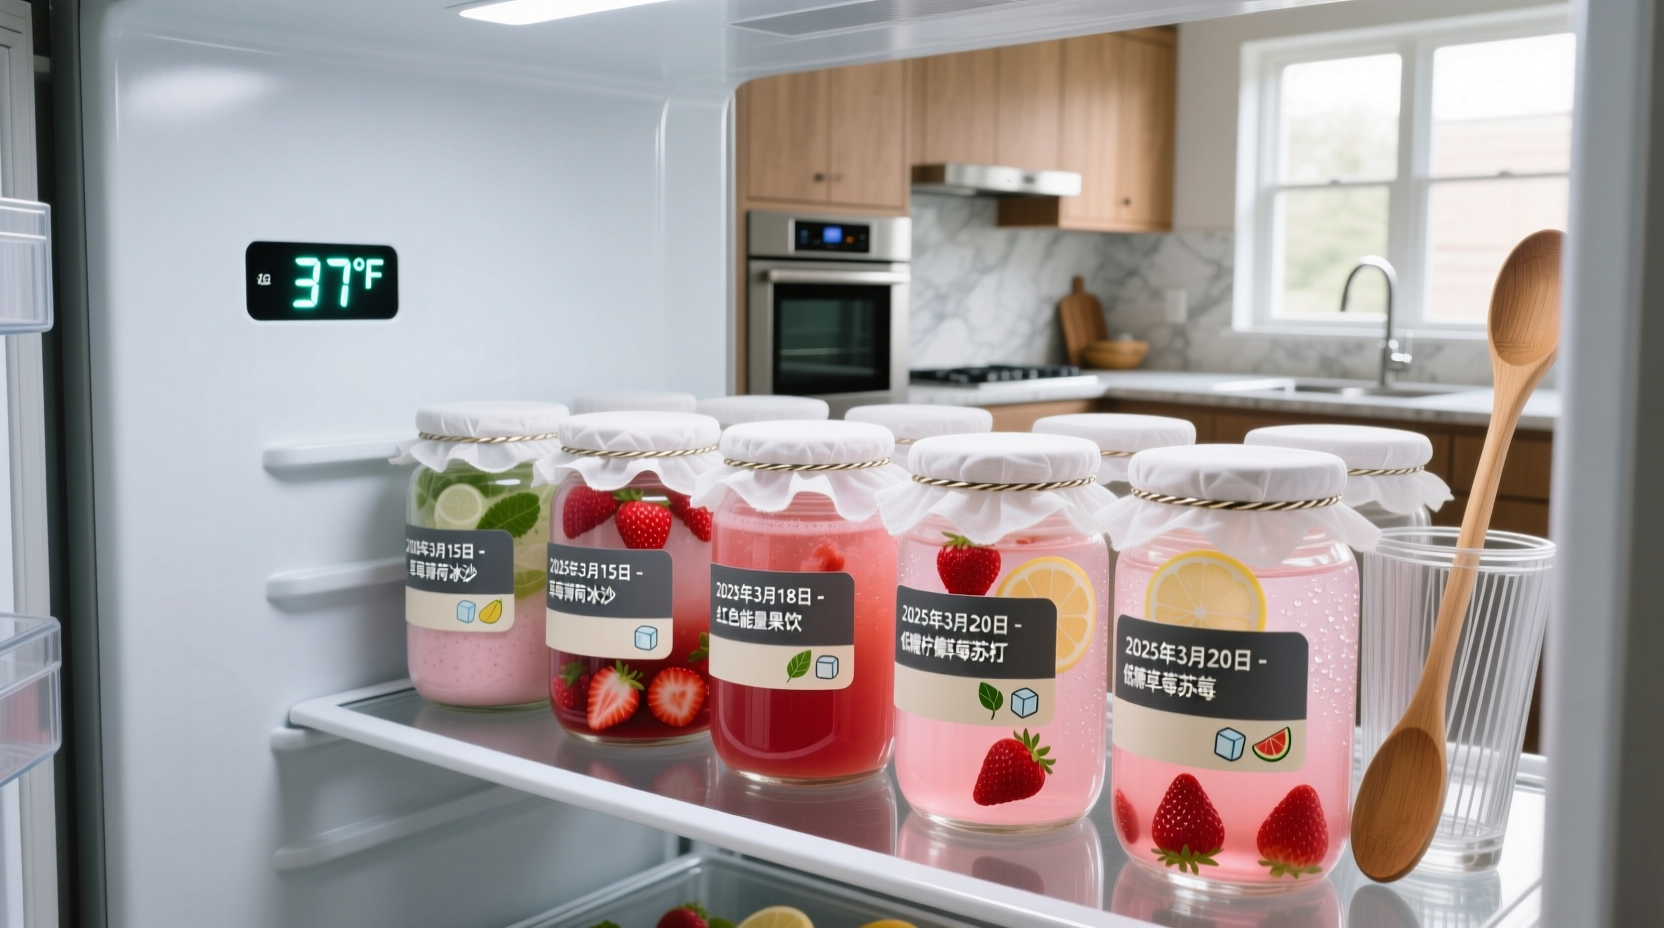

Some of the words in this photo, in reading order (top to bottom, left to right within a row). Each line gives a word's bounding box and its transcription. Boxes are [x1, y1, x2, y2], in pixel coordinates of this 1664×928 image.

[716, 581, 811, 606] 2025年3月18日
[901, 605, 1008, 635] 2025年3月20日
[1125, 636, 1251, 671] 2025年3月20日
